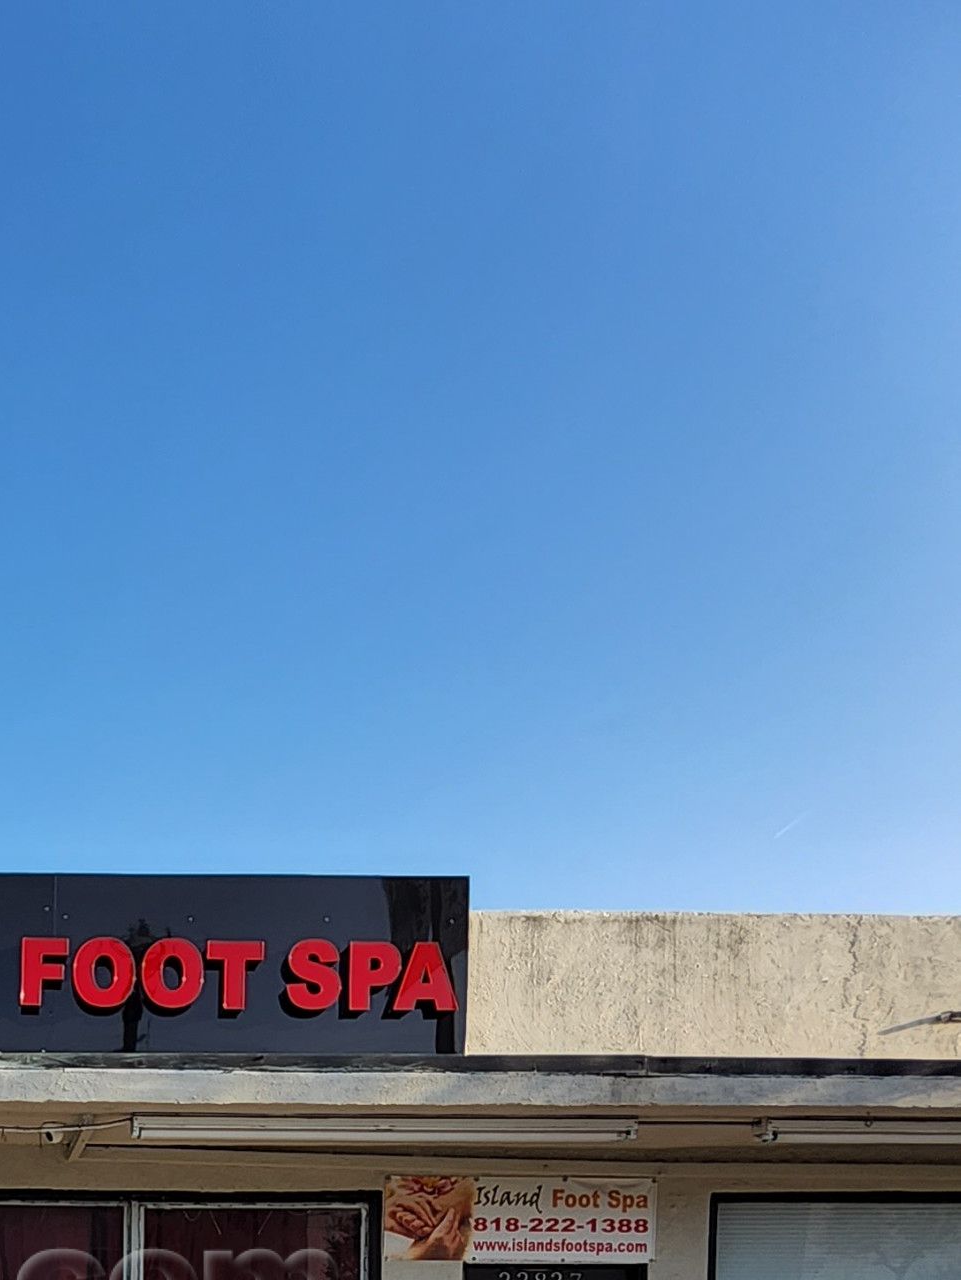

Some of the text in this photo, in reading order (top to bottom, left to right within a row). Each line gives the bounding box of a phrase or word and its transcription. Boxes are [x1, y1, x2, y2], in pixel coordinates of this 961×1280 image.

[20, 936, 265, 1011] FOOT
[285, 937, 459, 1012] SPA
[473, 1184, 649, 1214] Island Foot Spa
[473, 1217, 649, 1234] 818-222-1388
[473, 1238, 648, 1256] www.islandsfootspa.com
